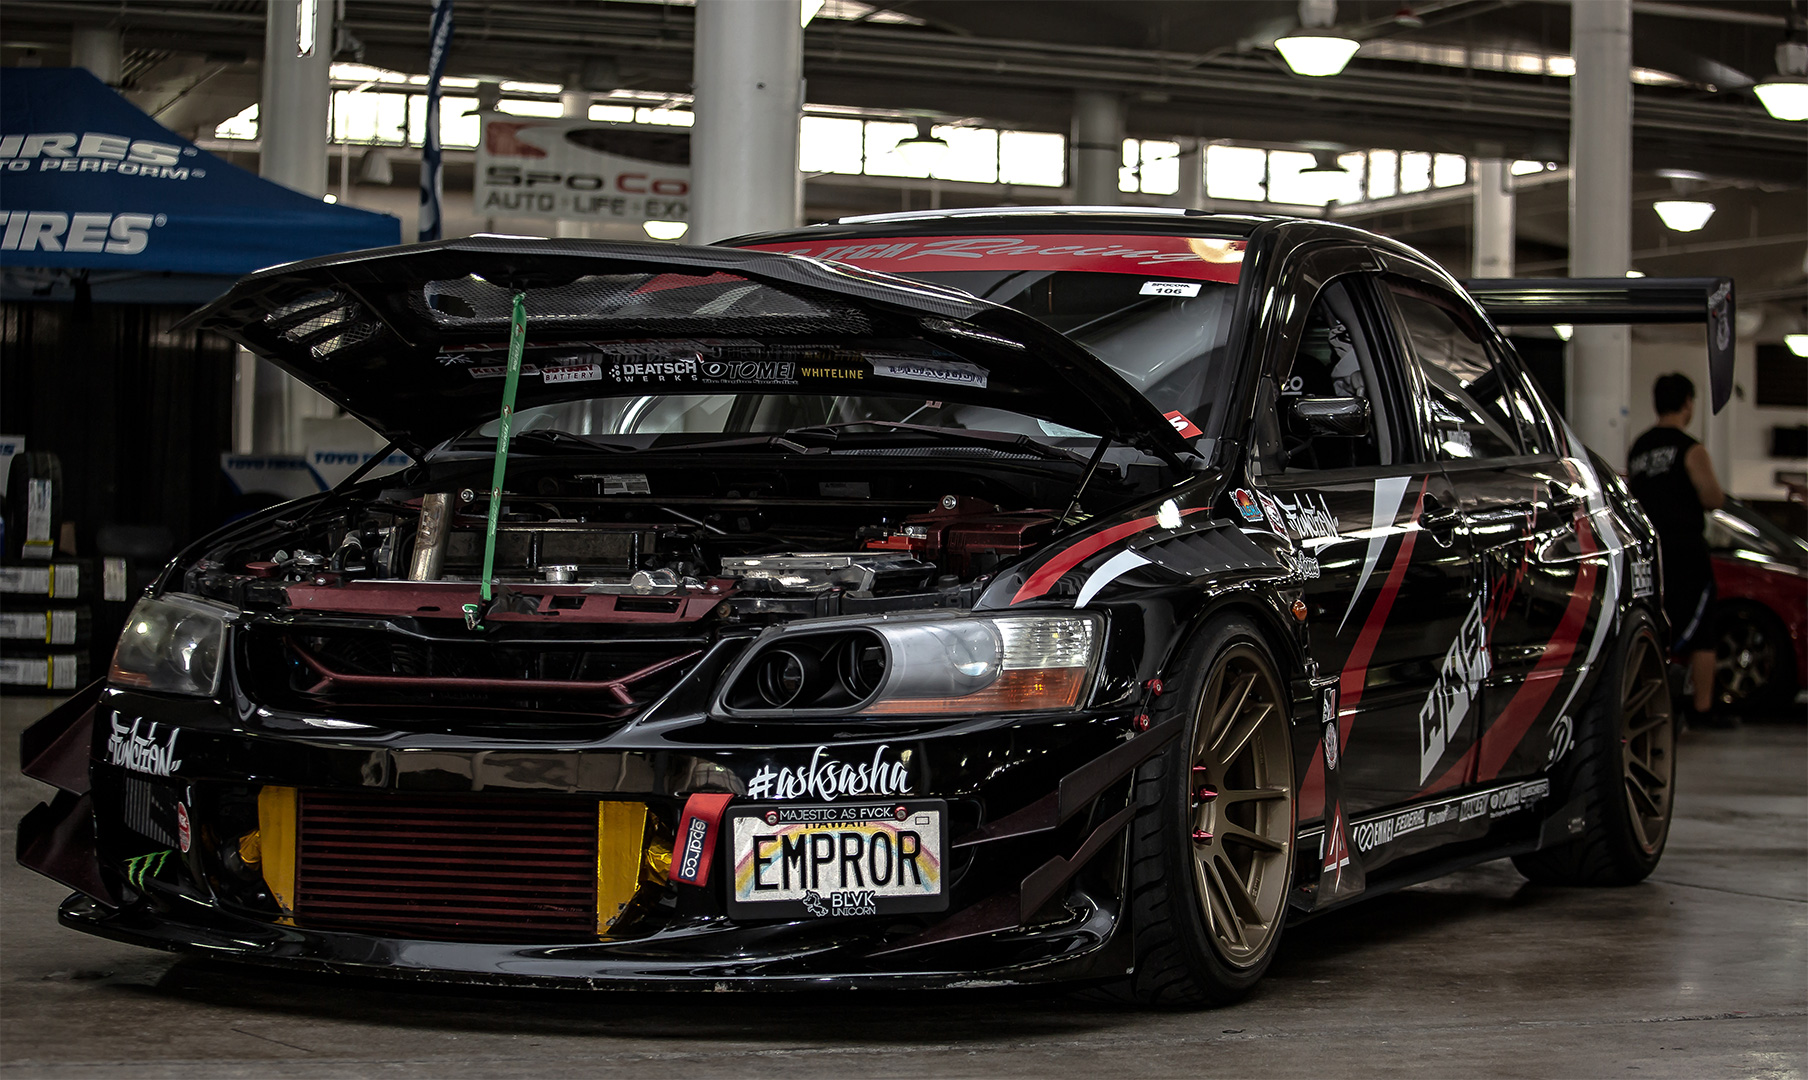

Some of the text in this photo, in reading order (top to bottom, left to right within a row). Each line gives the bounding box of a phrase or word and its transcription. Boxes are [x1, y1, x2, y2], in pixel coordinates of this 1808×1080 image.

[0, 132, 182, 167] IRES
[485, 192, 556, 212] AUTO
[573, 196, 626, 216] LIFE
[1156, 287, 1183, 295] 106
[545, 371, 594, 381] BATTERY
[623, 362, 697, 375] DEATSCH
[728, 361, 796, 379] TOMEI
[801, 367, 864, 380] WHITELINE
[624, 375, 698, 383] WERKS
[314, 452, 359, 465] TOYO
[748, 745, 913, 801] #asksasha
[779, 809, 837, 821] MAJESTIC
[840, 808, 857, 820] AS
[1374, 818, 1394, 847] ENKEI
[1394, 808, 1426, 833] FEDERAL
[684, 820, 708, 879] sparco
[752, 831, 922, 891] EMPROR
[831, 891, 876, 908] BLVK
[831, 905, 876, 917] UNICORN
